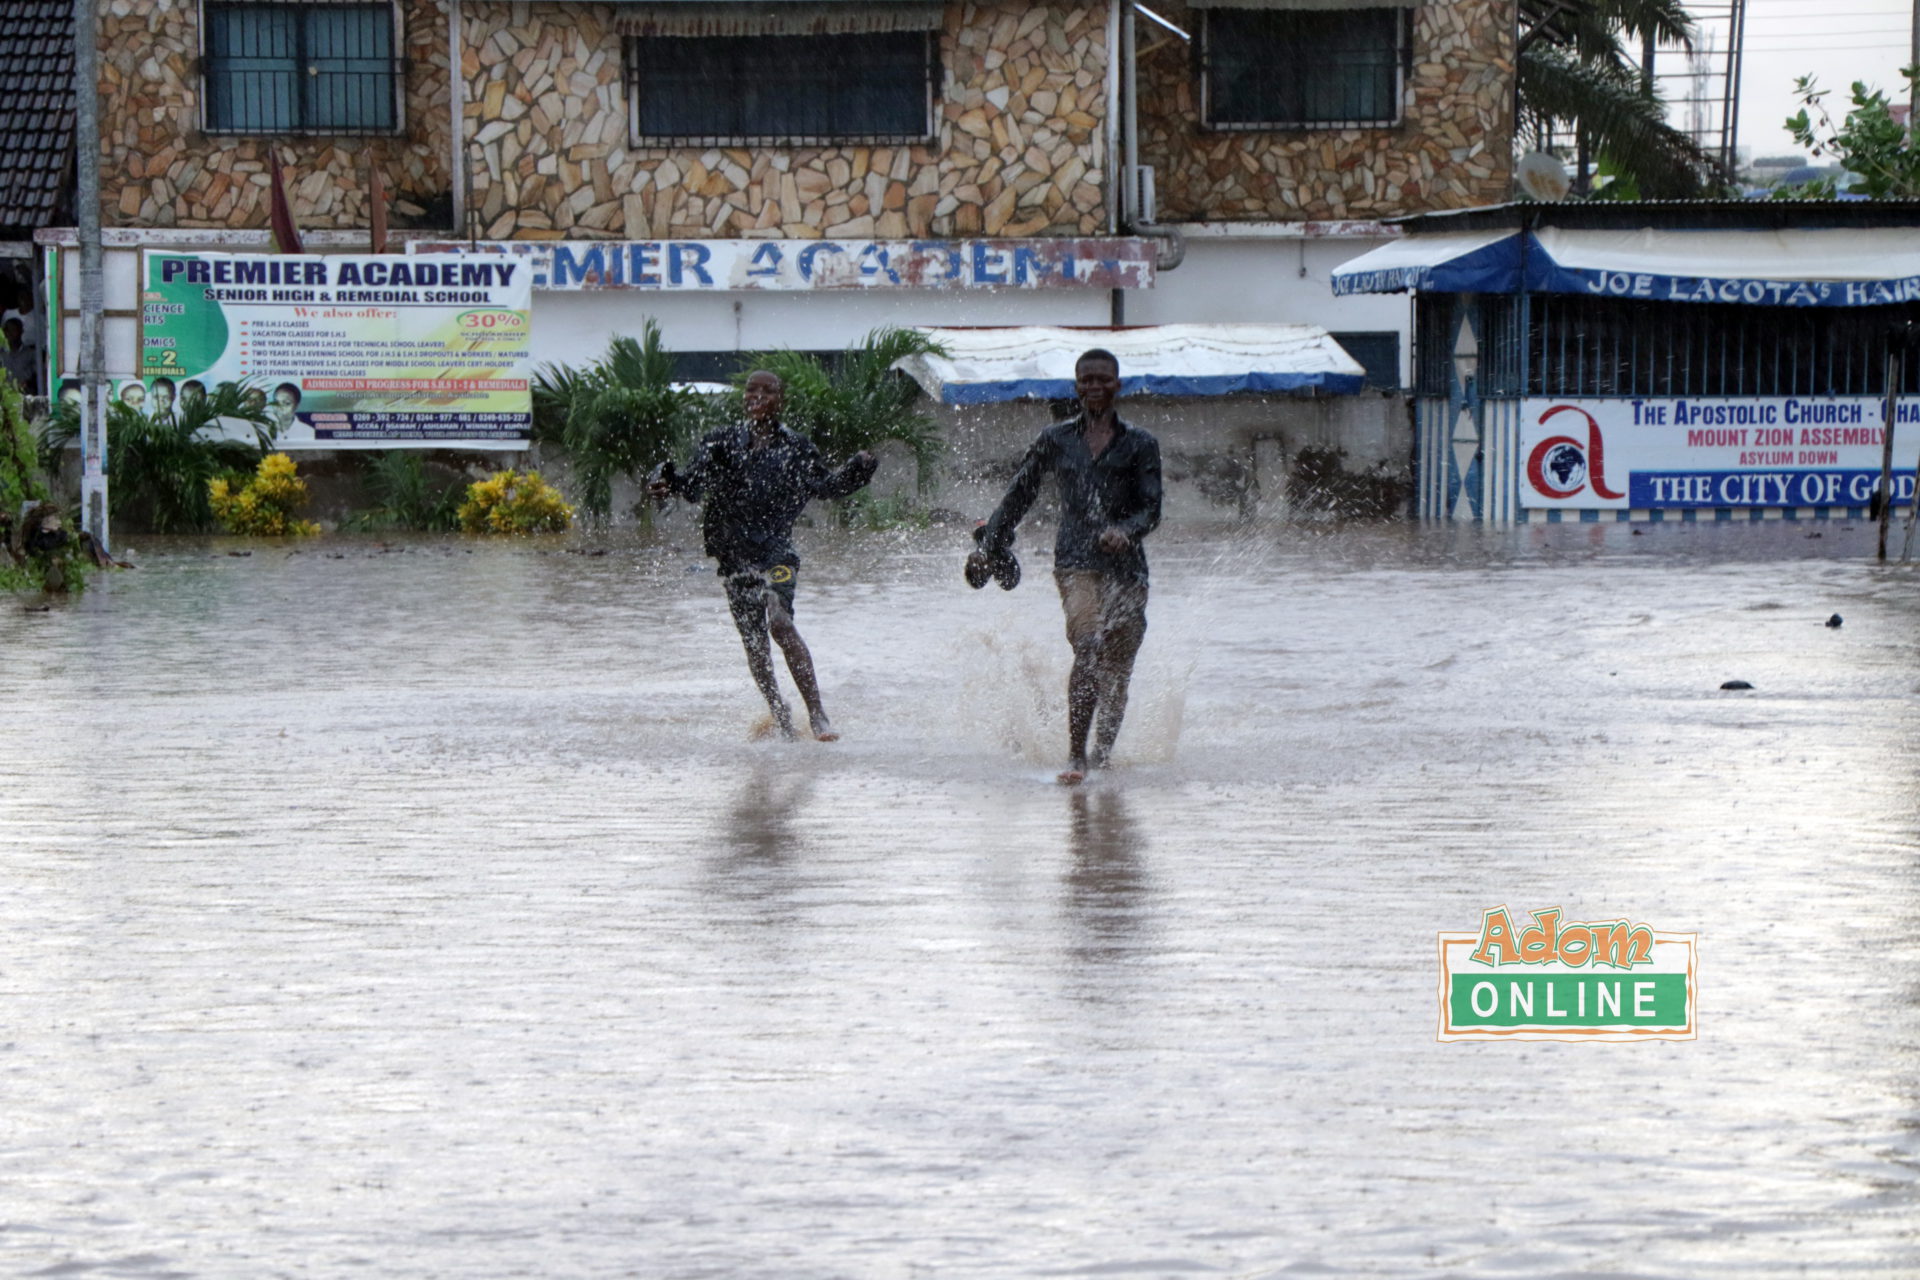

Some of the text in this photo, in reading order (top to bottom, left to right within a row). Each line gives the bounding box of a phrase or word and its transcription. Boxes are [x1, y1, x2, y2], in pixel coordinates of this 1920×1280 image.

[162, 259, 516, 286] PREMIER ACADEMY
[745, 240, 1122, 290] ACADEM
[204, 288, 491, 303] SENIOR HIGH & REMEDIAL SCHOOL
[1588, 271, 1653, 296] JOE
[1846, 278, 1920, 305] HAIR
[143, 304, 184, 314] CIENCE
[294, 307, 398, 319] We also offer:
[144, 315, 164, 325] RTS
[465, 313, 521, 328] 30%
[143, 337, 175, 347] OMICS
[162, 350, 176, 366] 2
[143, 367, 186, 376] EMEDIALS
[306, 380, 353, 389] ADMISSION
[355, 380, 365, 389] IN
[413, 380, 429, 389] FOR
[1688, 428, 1887, 447] MOUNT ZION ASSEMBLY
[1739, 451, 1838, 465] ASYLUM DOWN
[1650, 476, 1712, 502] THE
[1719, 474, 1794, 503] CITY
[1800, 473, 1848, 503] OF
